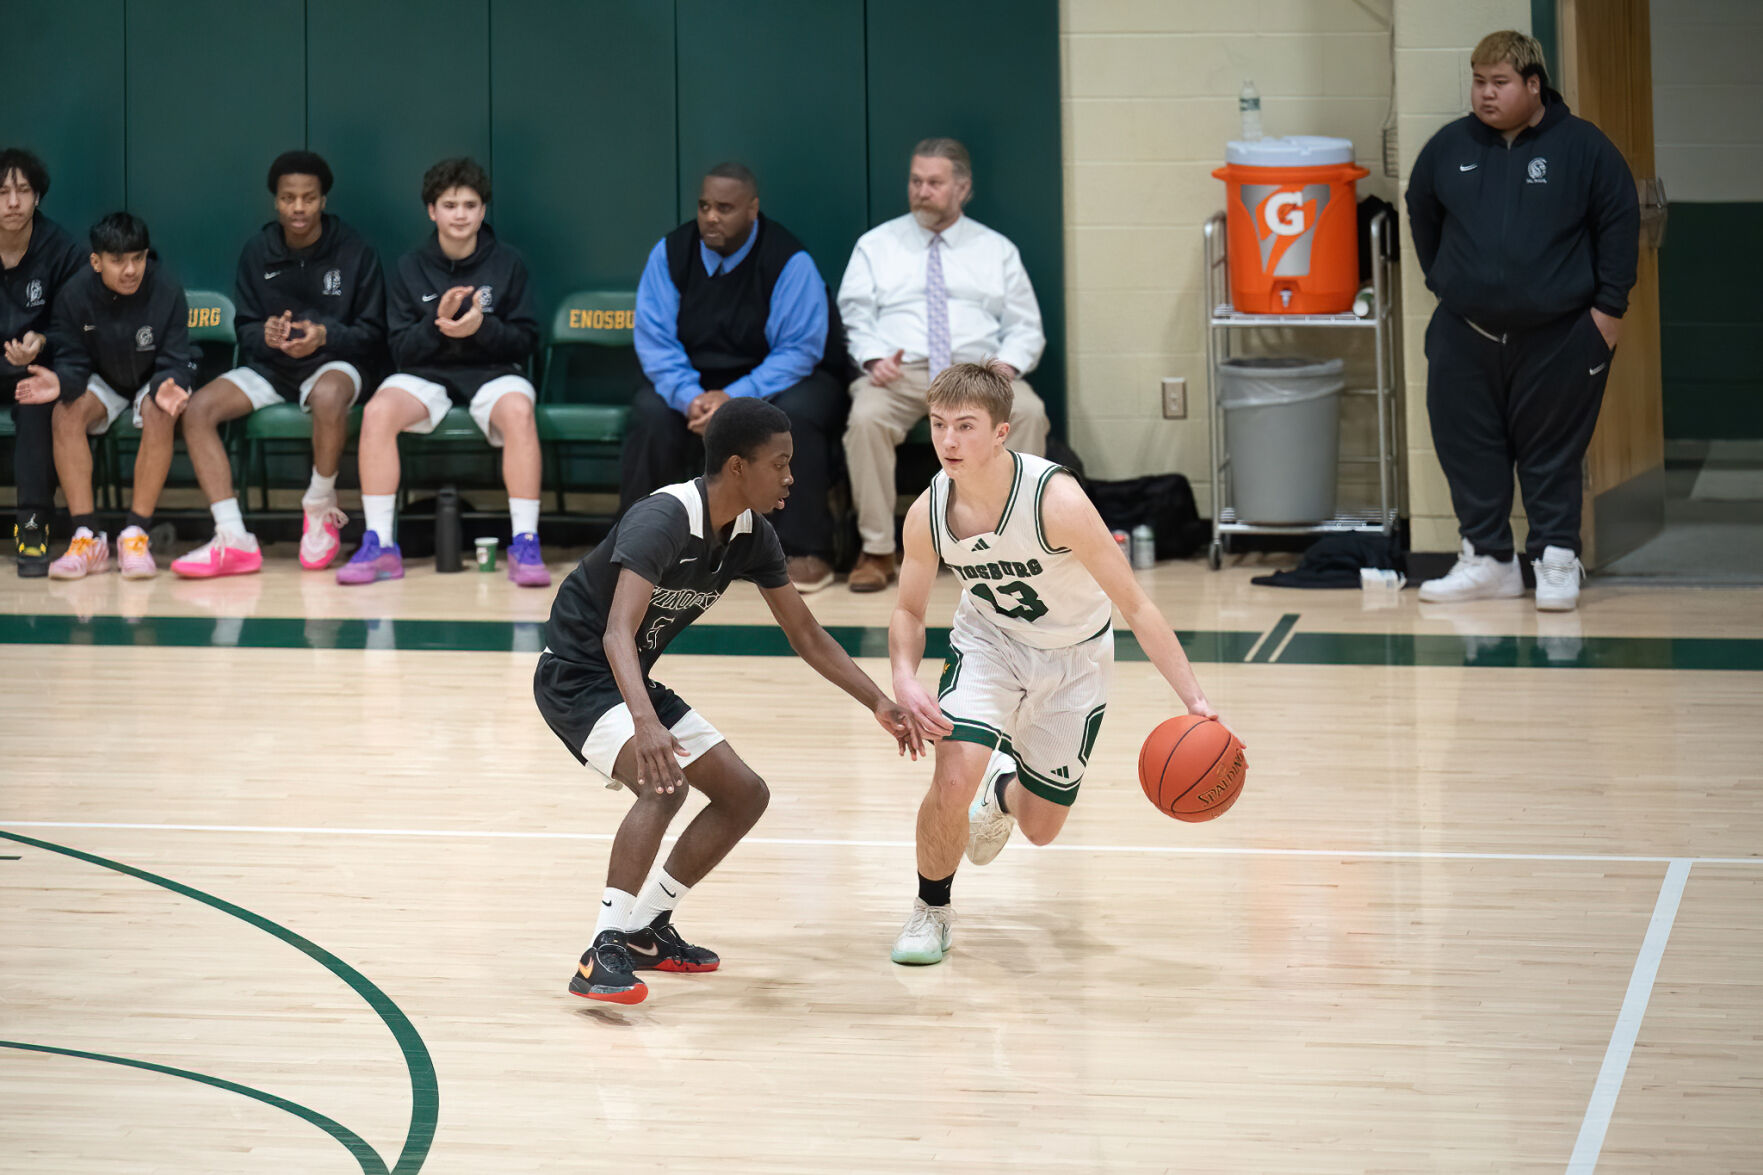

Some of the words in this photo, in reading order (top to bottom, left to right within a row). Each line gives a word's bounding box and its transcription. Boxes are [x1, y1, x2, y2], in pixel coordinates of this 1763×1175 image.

[1264, 191, 1305, 236] G
[187, 307, 221, 328] URG
[569, 309, 636, 330] ENOSBU
[970, 580, 1049, 623] 13
[1197, 748, 1244, 807] SPALDING
